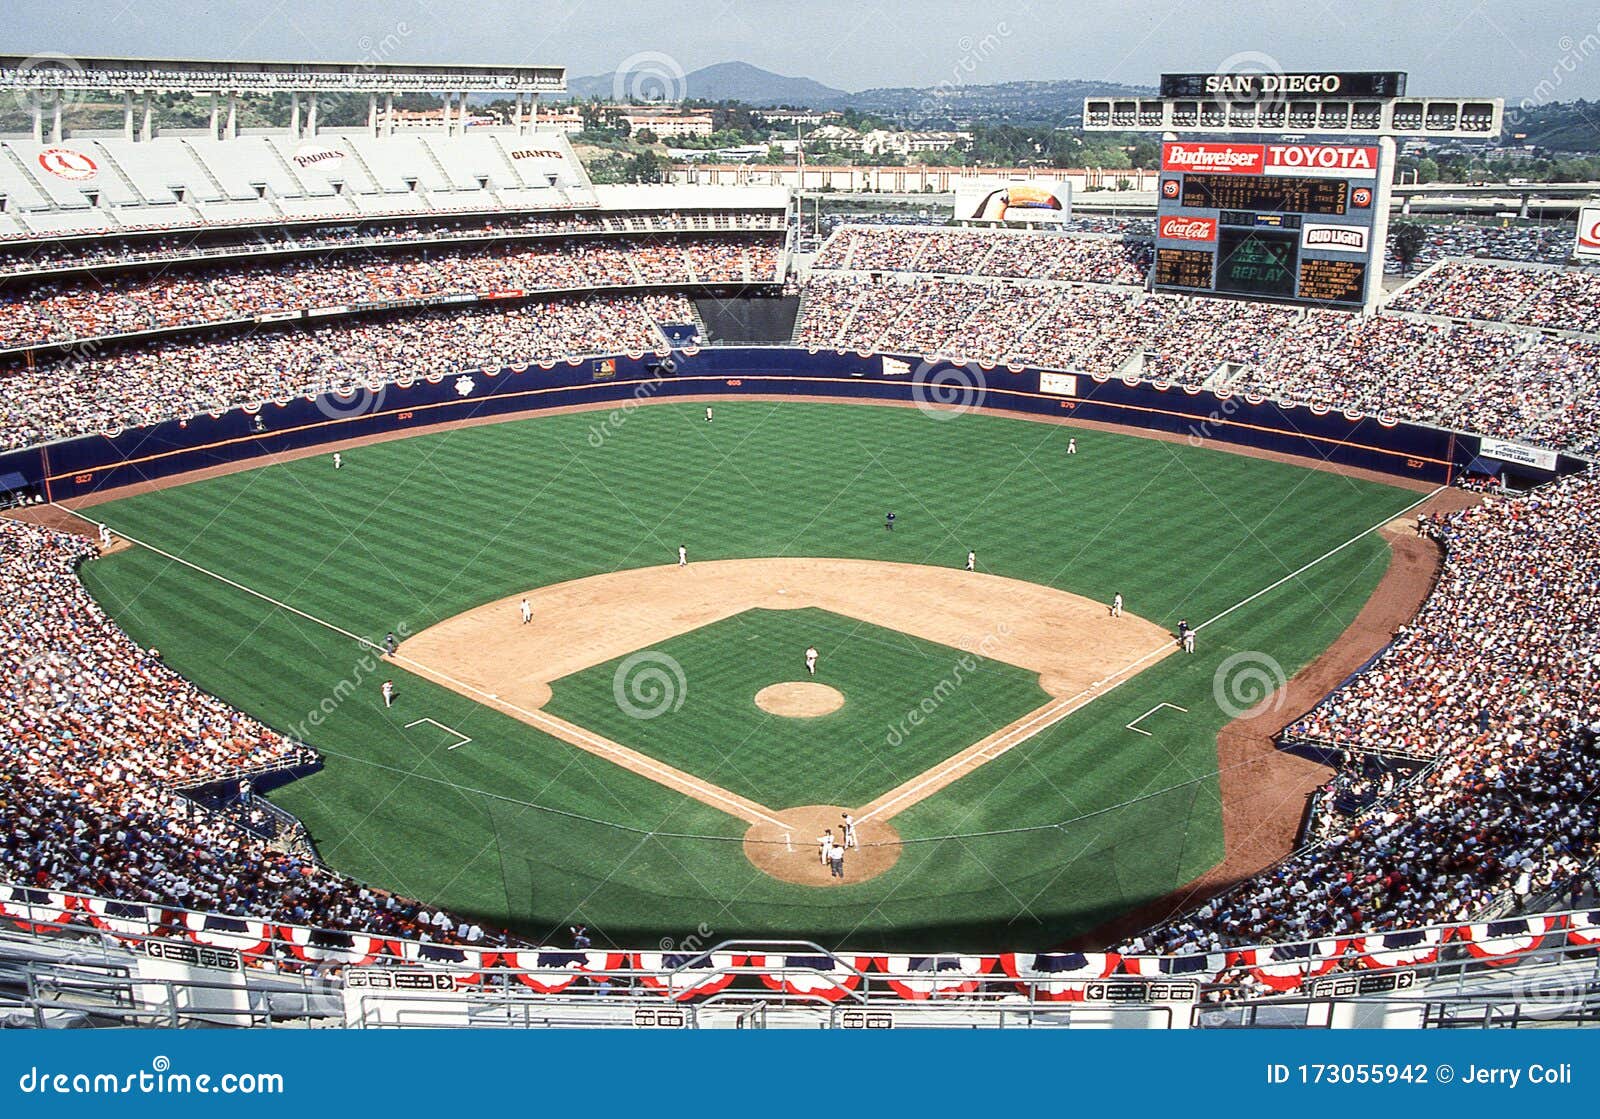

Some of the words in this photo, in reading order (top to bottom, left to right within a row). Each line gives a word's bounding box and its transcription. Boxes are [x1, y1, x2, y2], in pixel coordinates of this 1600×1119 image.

[1205, 75, 1254, 92] SAN
[1260, 75, 1341, 92] DIEGO
[293, 151, 345, 168] PADRES
[511, 150, 563, 160] GIANTS
[1167, 146, 1259, 166] Budweiser
[1269, 146, 1370, 168] TOYOTA
[1338, 183, 1346, 192] 2
[1337, 194, 1345, 203] 2
[1308, 230, 1331, 243] BUD
[1331, 230, 1361, 246] LIGHT
[1231, 266, 1286, 280] REPLAY
[1514, 454, 1536, 463] LEAGUE
